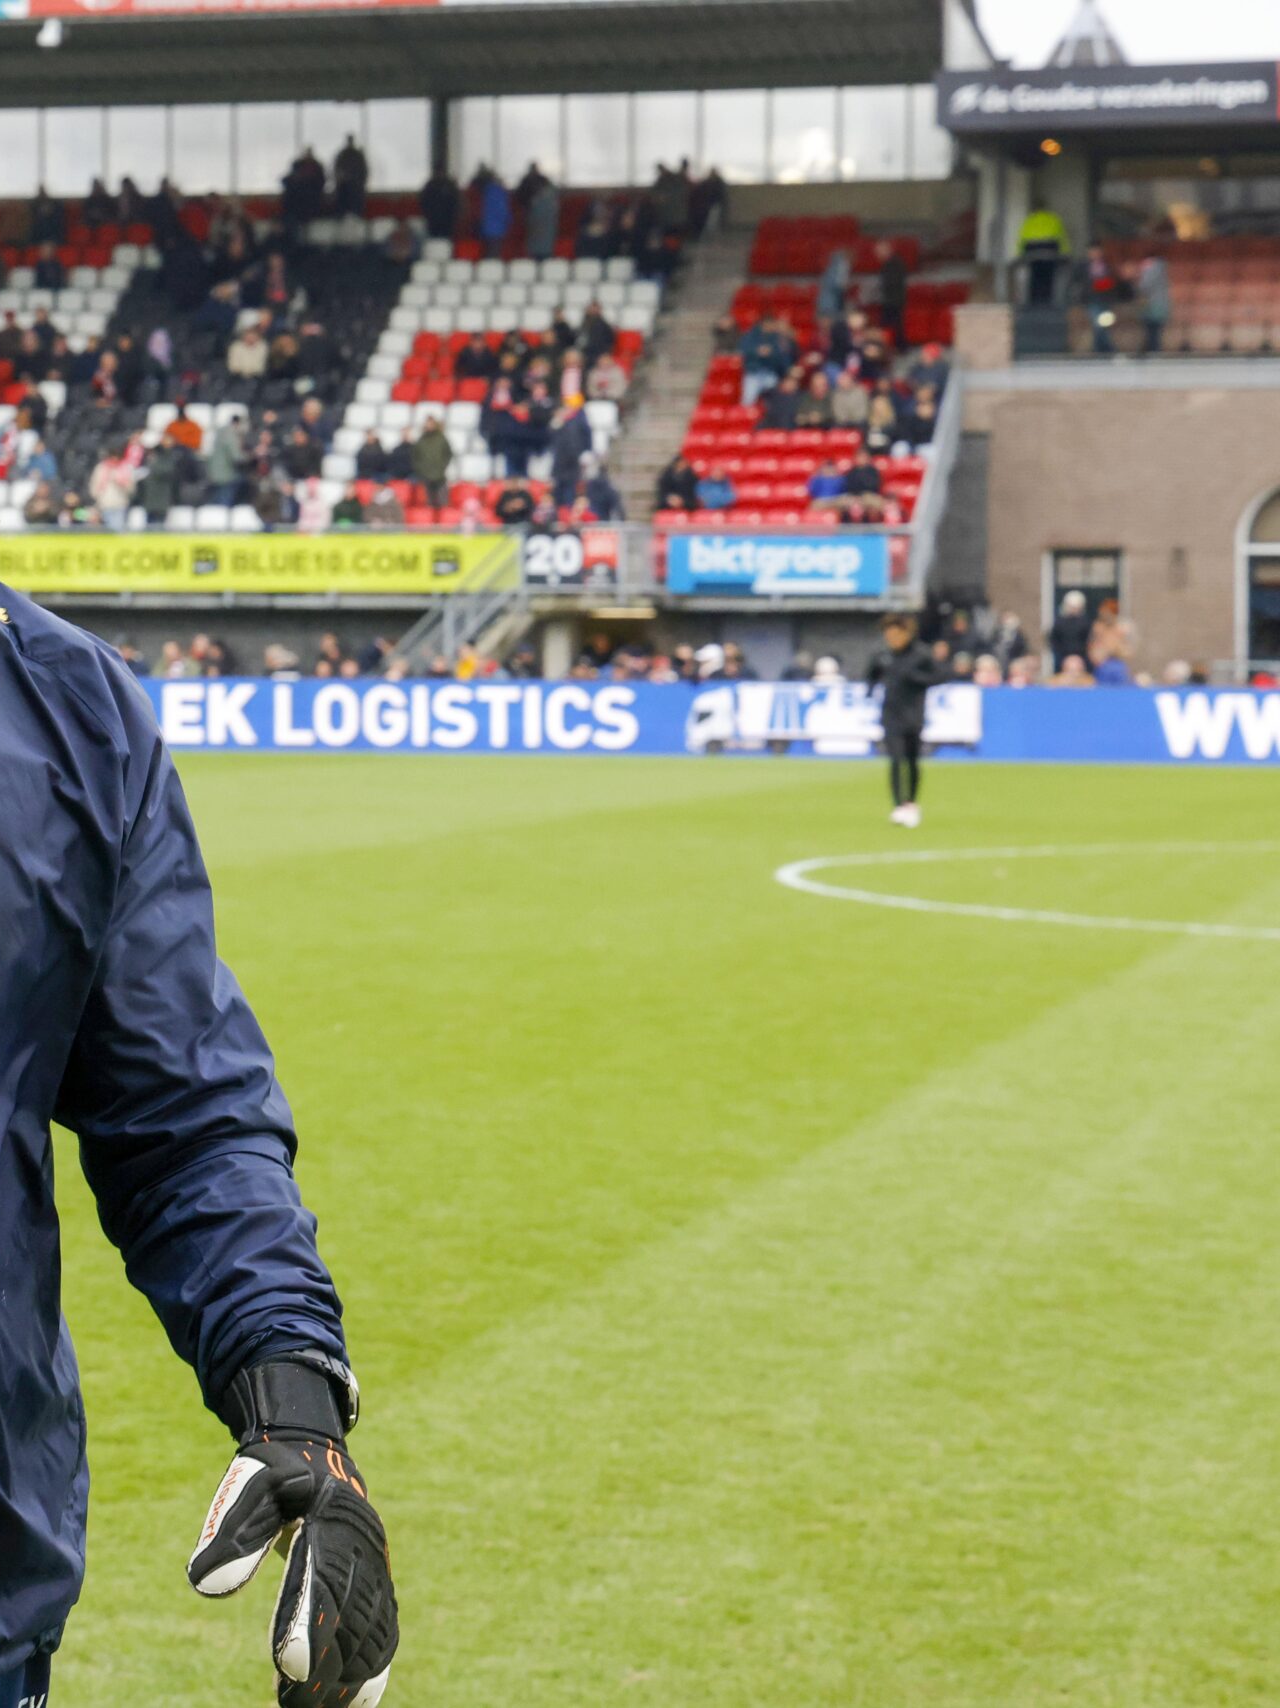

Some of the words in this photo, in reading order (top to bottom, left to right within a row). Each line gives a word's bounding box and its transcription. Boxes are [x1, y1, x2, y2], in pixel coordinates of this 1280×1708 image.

[524, 533, 583, 577] 20
[161, 683, 258, 746] EK
[272, 684, 640, 750] LOGISTICS
